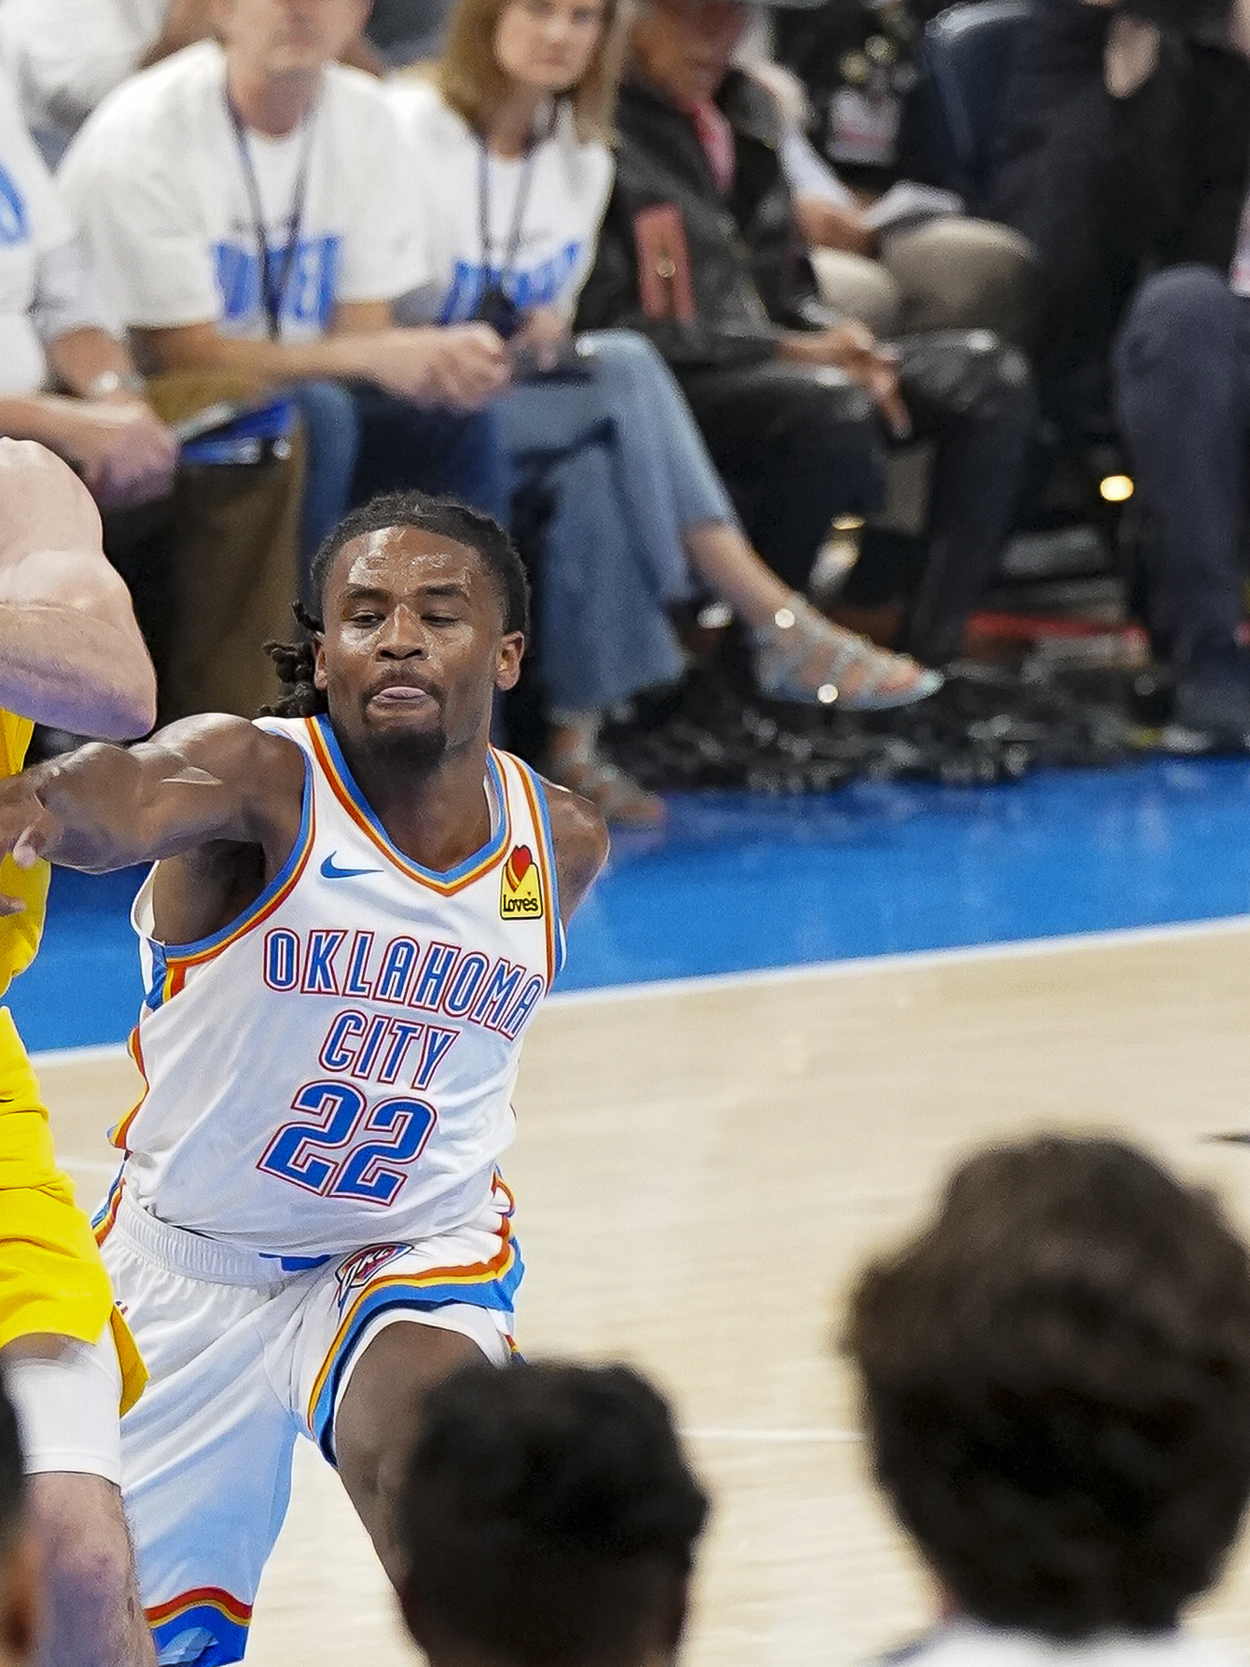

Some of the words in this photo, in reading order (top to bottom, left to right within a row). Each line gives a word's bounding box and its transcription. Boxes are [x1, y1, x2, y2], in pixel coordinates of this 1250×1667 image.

[503, 891, 538, 912] Love's
[264, 928, 545, 1041] OKLAHOMA
[319, 1009, 460, 1090] CITY
[256, 1079, 438, 1206] 22
